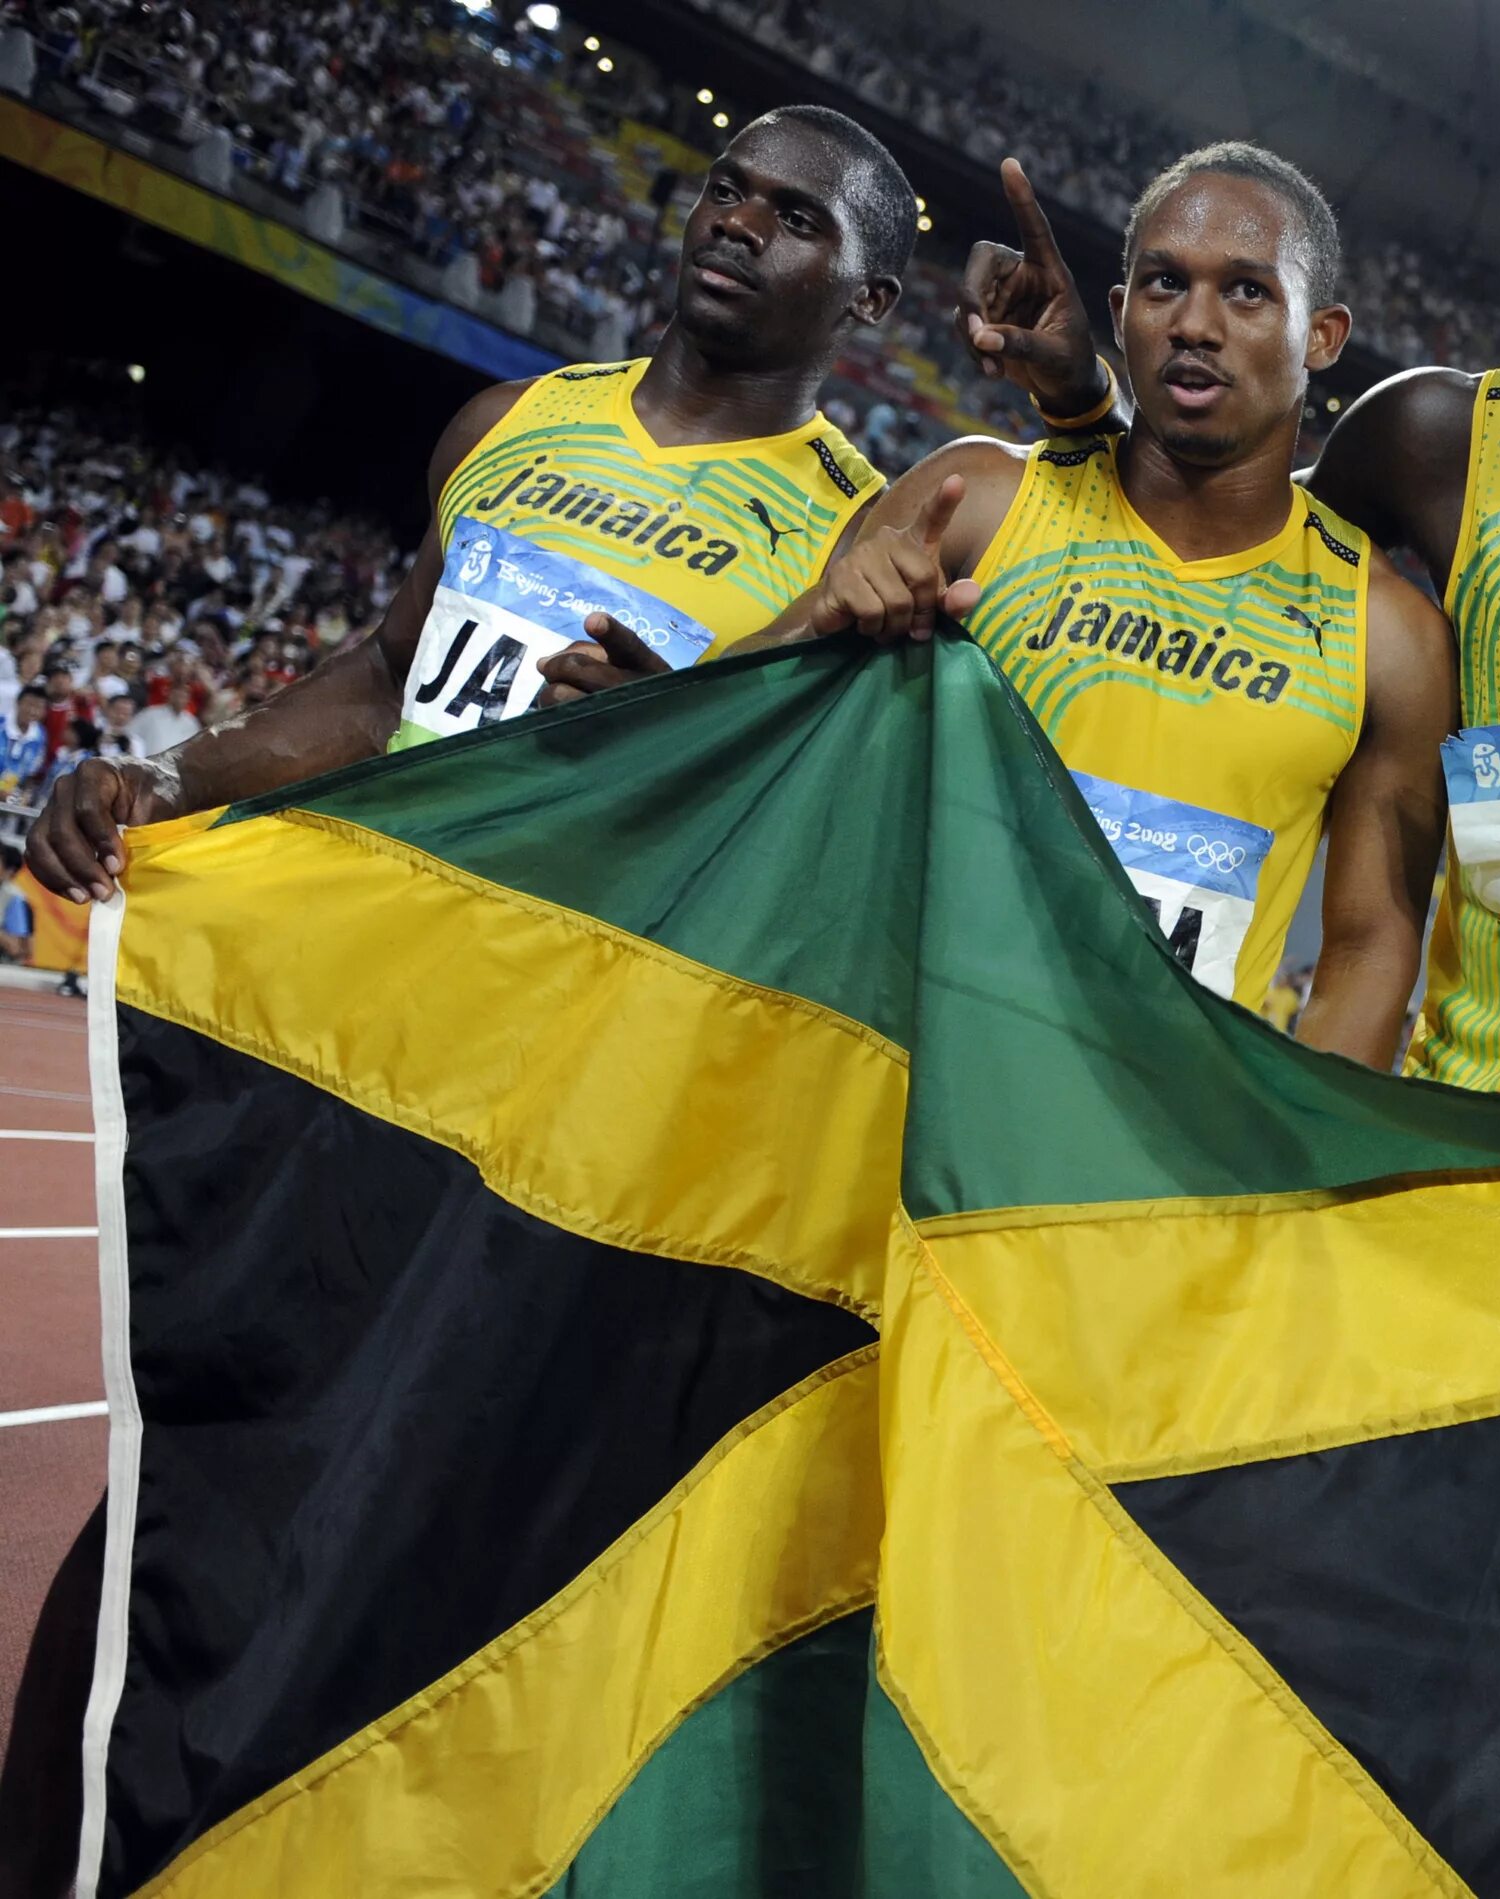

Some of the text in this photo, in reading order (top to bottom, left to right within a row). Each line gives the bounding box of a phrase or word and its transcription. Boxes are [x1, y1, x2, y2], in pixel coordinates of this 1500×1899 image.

[477, 455, 741, 577] jamaica
[497, 559, 559, 607] Beijing
[415, 619, 541, 728] JA
[1026, 582, 1292, 705] jamaica
[1124, 822, 1178, 852] 2008
